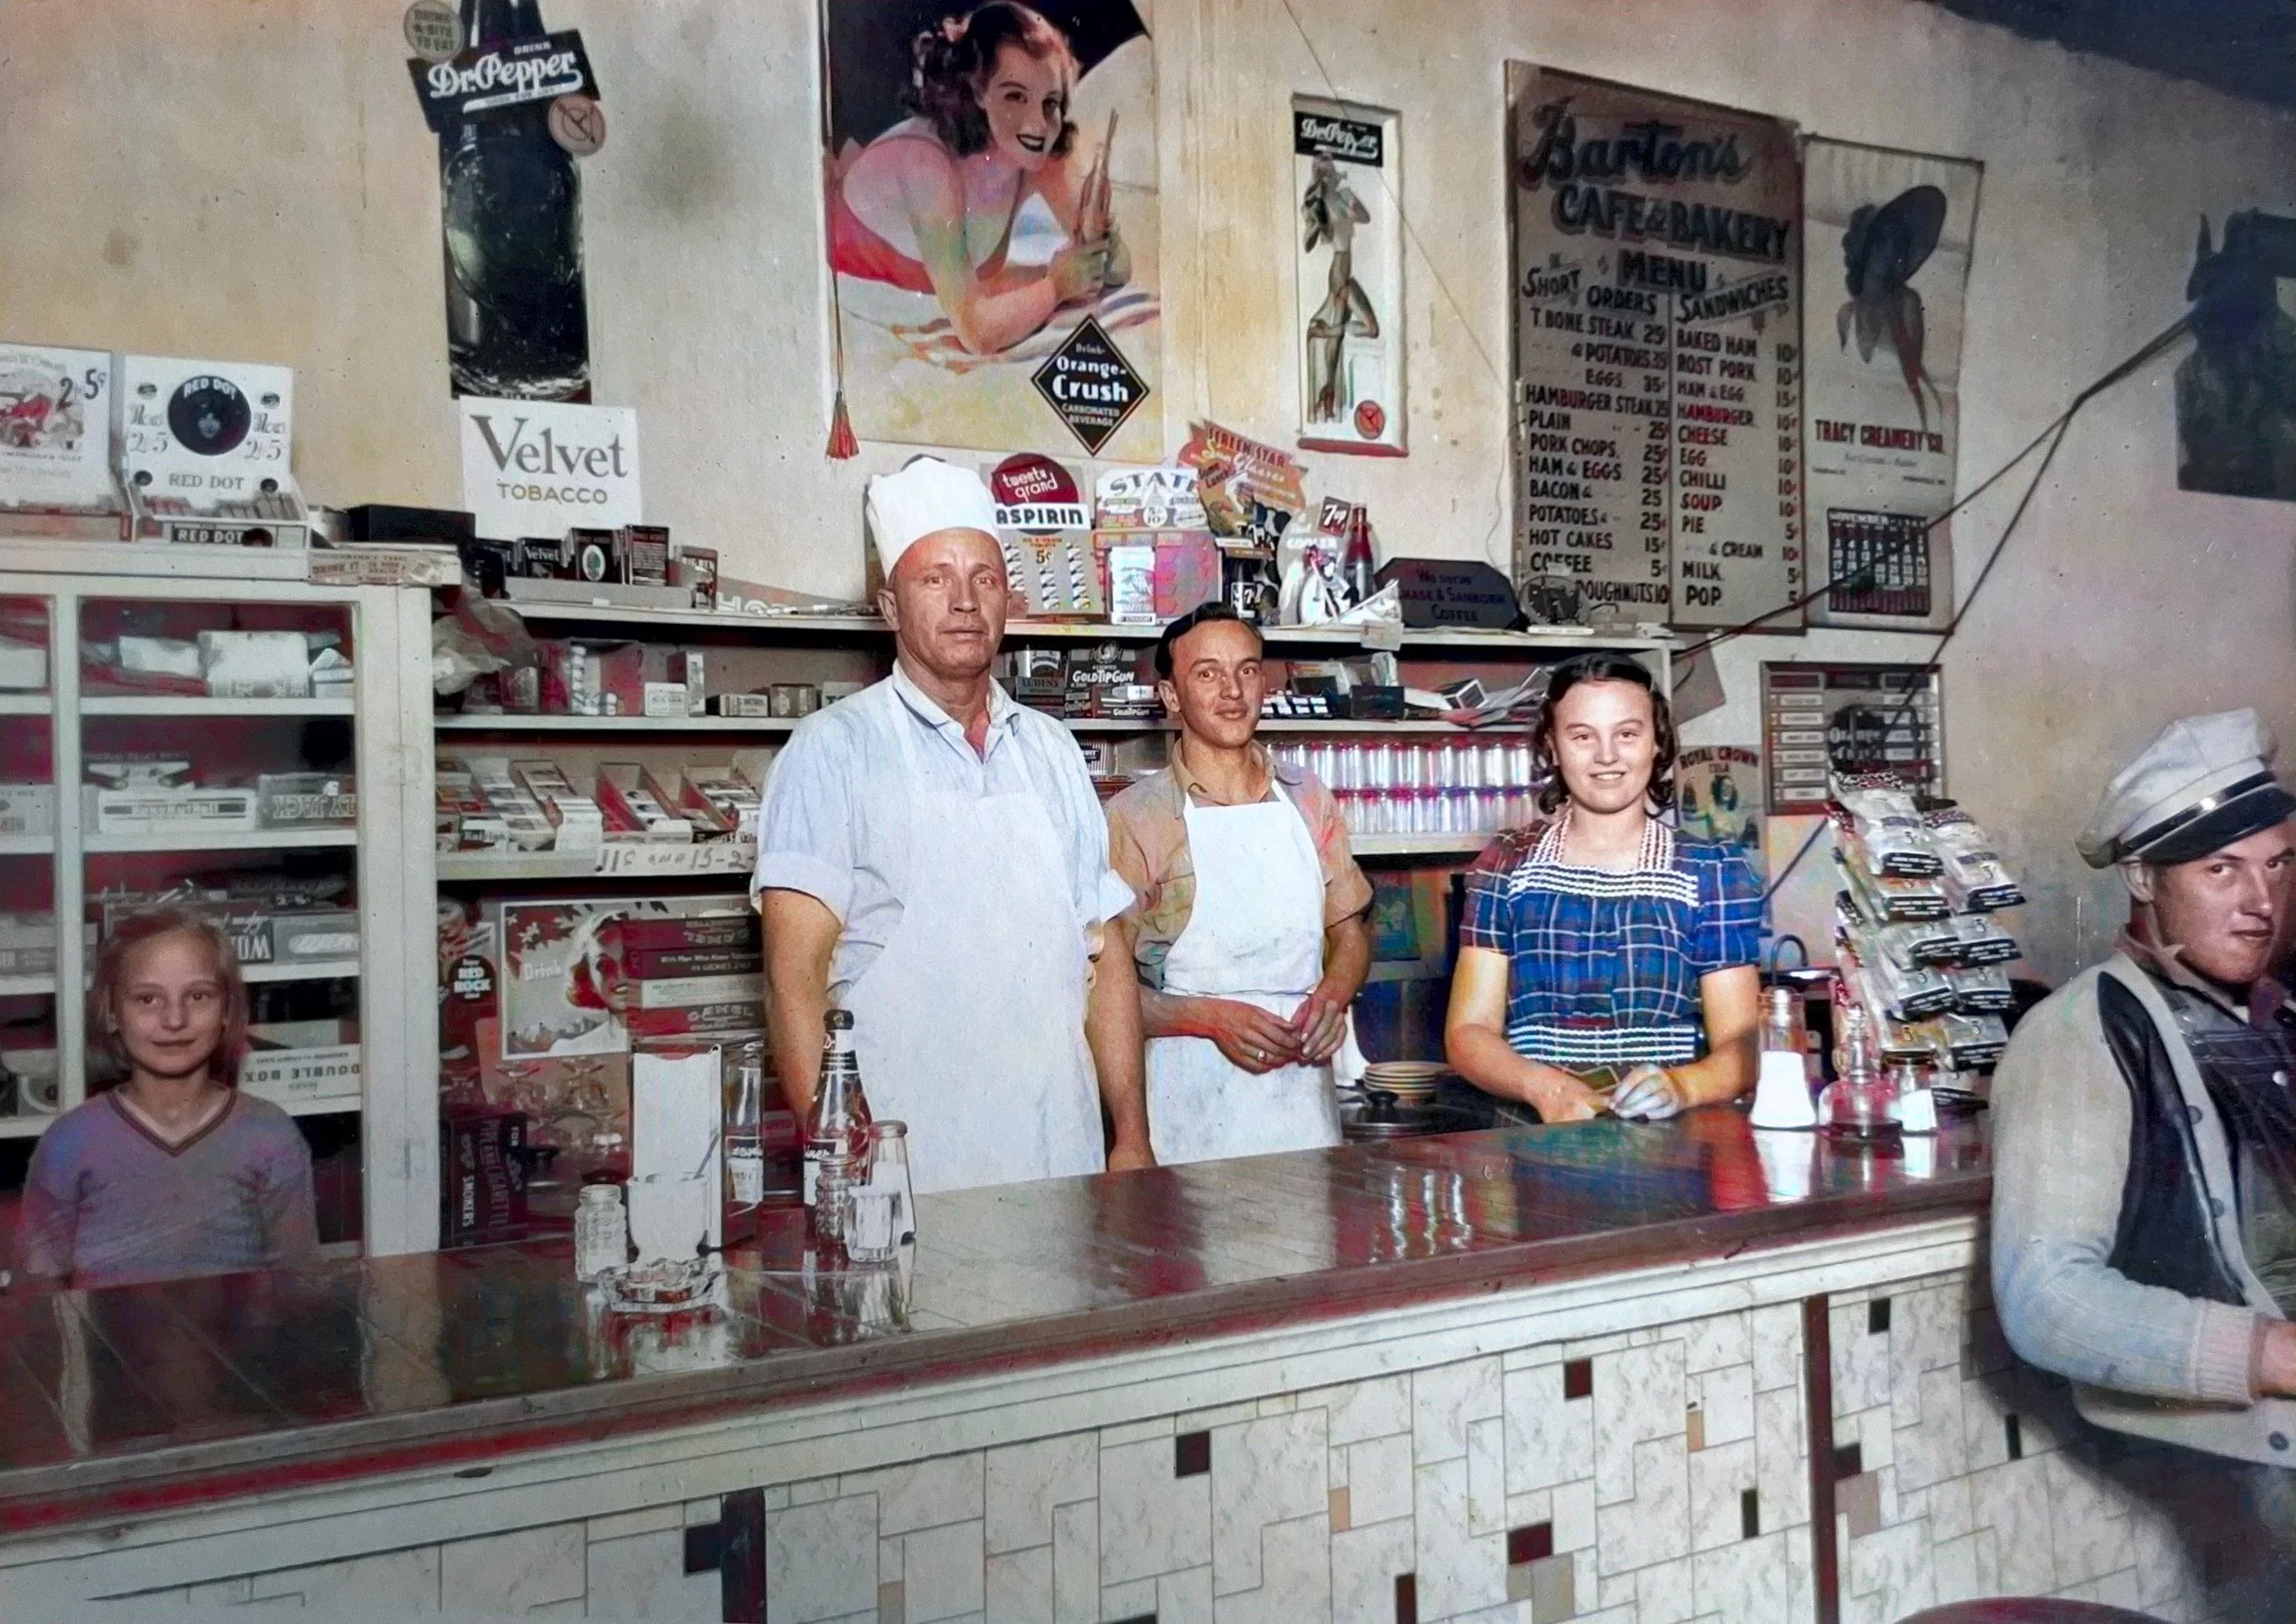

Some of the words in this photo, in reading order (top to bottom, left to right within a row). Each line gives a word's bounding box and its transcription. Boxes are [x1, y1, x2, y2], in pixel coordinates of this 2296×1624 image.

[1516, 96, 1751, 187] Barton's
[1551, 185, 1646, 242] CAFE
[1668, 201, 1791, 264] BAKERY
[1617, 249, 1706, 292] MENU
[1522, 266, 1581, 298] SHORT
[1586, 285, 1657, 315] ORDERS
[1675, 276, 1789, 323] SANDWICHES
[1546, 310, 1583, 333] BONE
[1588, 316, 1635, 340] STEAK
[1677, 328, 1721, 352] BAKED
[1726, 335, 1757, 357] HAM
[1585, 343, 1649, 367] POTATOES
[1677, 353, 1713, 375] ROST
[1719, 359, 1757, 382] PORK
[184, 378, 209, 399] RED
[212, 378, 237, 400] DOT
[1052, 374, 1129, 401] Crush
[1677, 380, 1705, 397] HAM
[1720, 384, 1744, 402] EGG
[1062, 403, 1120, 417] CARBONATED
[1526, 384, 1611, 411] HAMBURGER
[1615, 395, 1652, 415] STEAK
[1069, 414, 1115, 426] BEVERAGE
[1529, 410, 1570, 430] PLAIN
[1677, 402, 1755, 426] HAMBURGER
[1530, 433, 1568, 452] PORK
[1678, 424, 1728, 445] CHEESE
[1815, 419, 1856, 445] TRACY
[1861, 424, 1923, 452] CREAMERY
[469, 415, 628, 479] Velvet
[1680, 447, 1706, 467] EGG
[1529, 456, 1563, 476] HAM
[169, 473, 203, 488] RED
[210, 476, 244, 490] DOT
[1002, 467, 1047, 489] twenty
[1014, 471, 1058, 502] grand
[1680, 469, 1727, 490] CHILLI
[497, 482, 608, 504] TOBACCO
[1529, 479, 1580, 500] BACON
[996, 508, 1084, 524] ASPIRIN
[1529, 504, 1598, 525] POTATOES
[1682, 515, 1705, 533] PIE
[178, 529, 208, 542] RED
[1529, 529, 1560, 546] HOT
[1566, 531, 1613, 549] CAKES
[1721, 540, 1763, 558] CREAM
[1680, 746, 1714, 770] ROYAL
[1717, 745, 1759, 768] CROWN
[458, 966, 485, 979] RED
[244, 1069, 281, 1083] BOX
[290, 1063, 360, 1080] DOUBLE
[462, 1175, 475, 1227] SMOKERS
